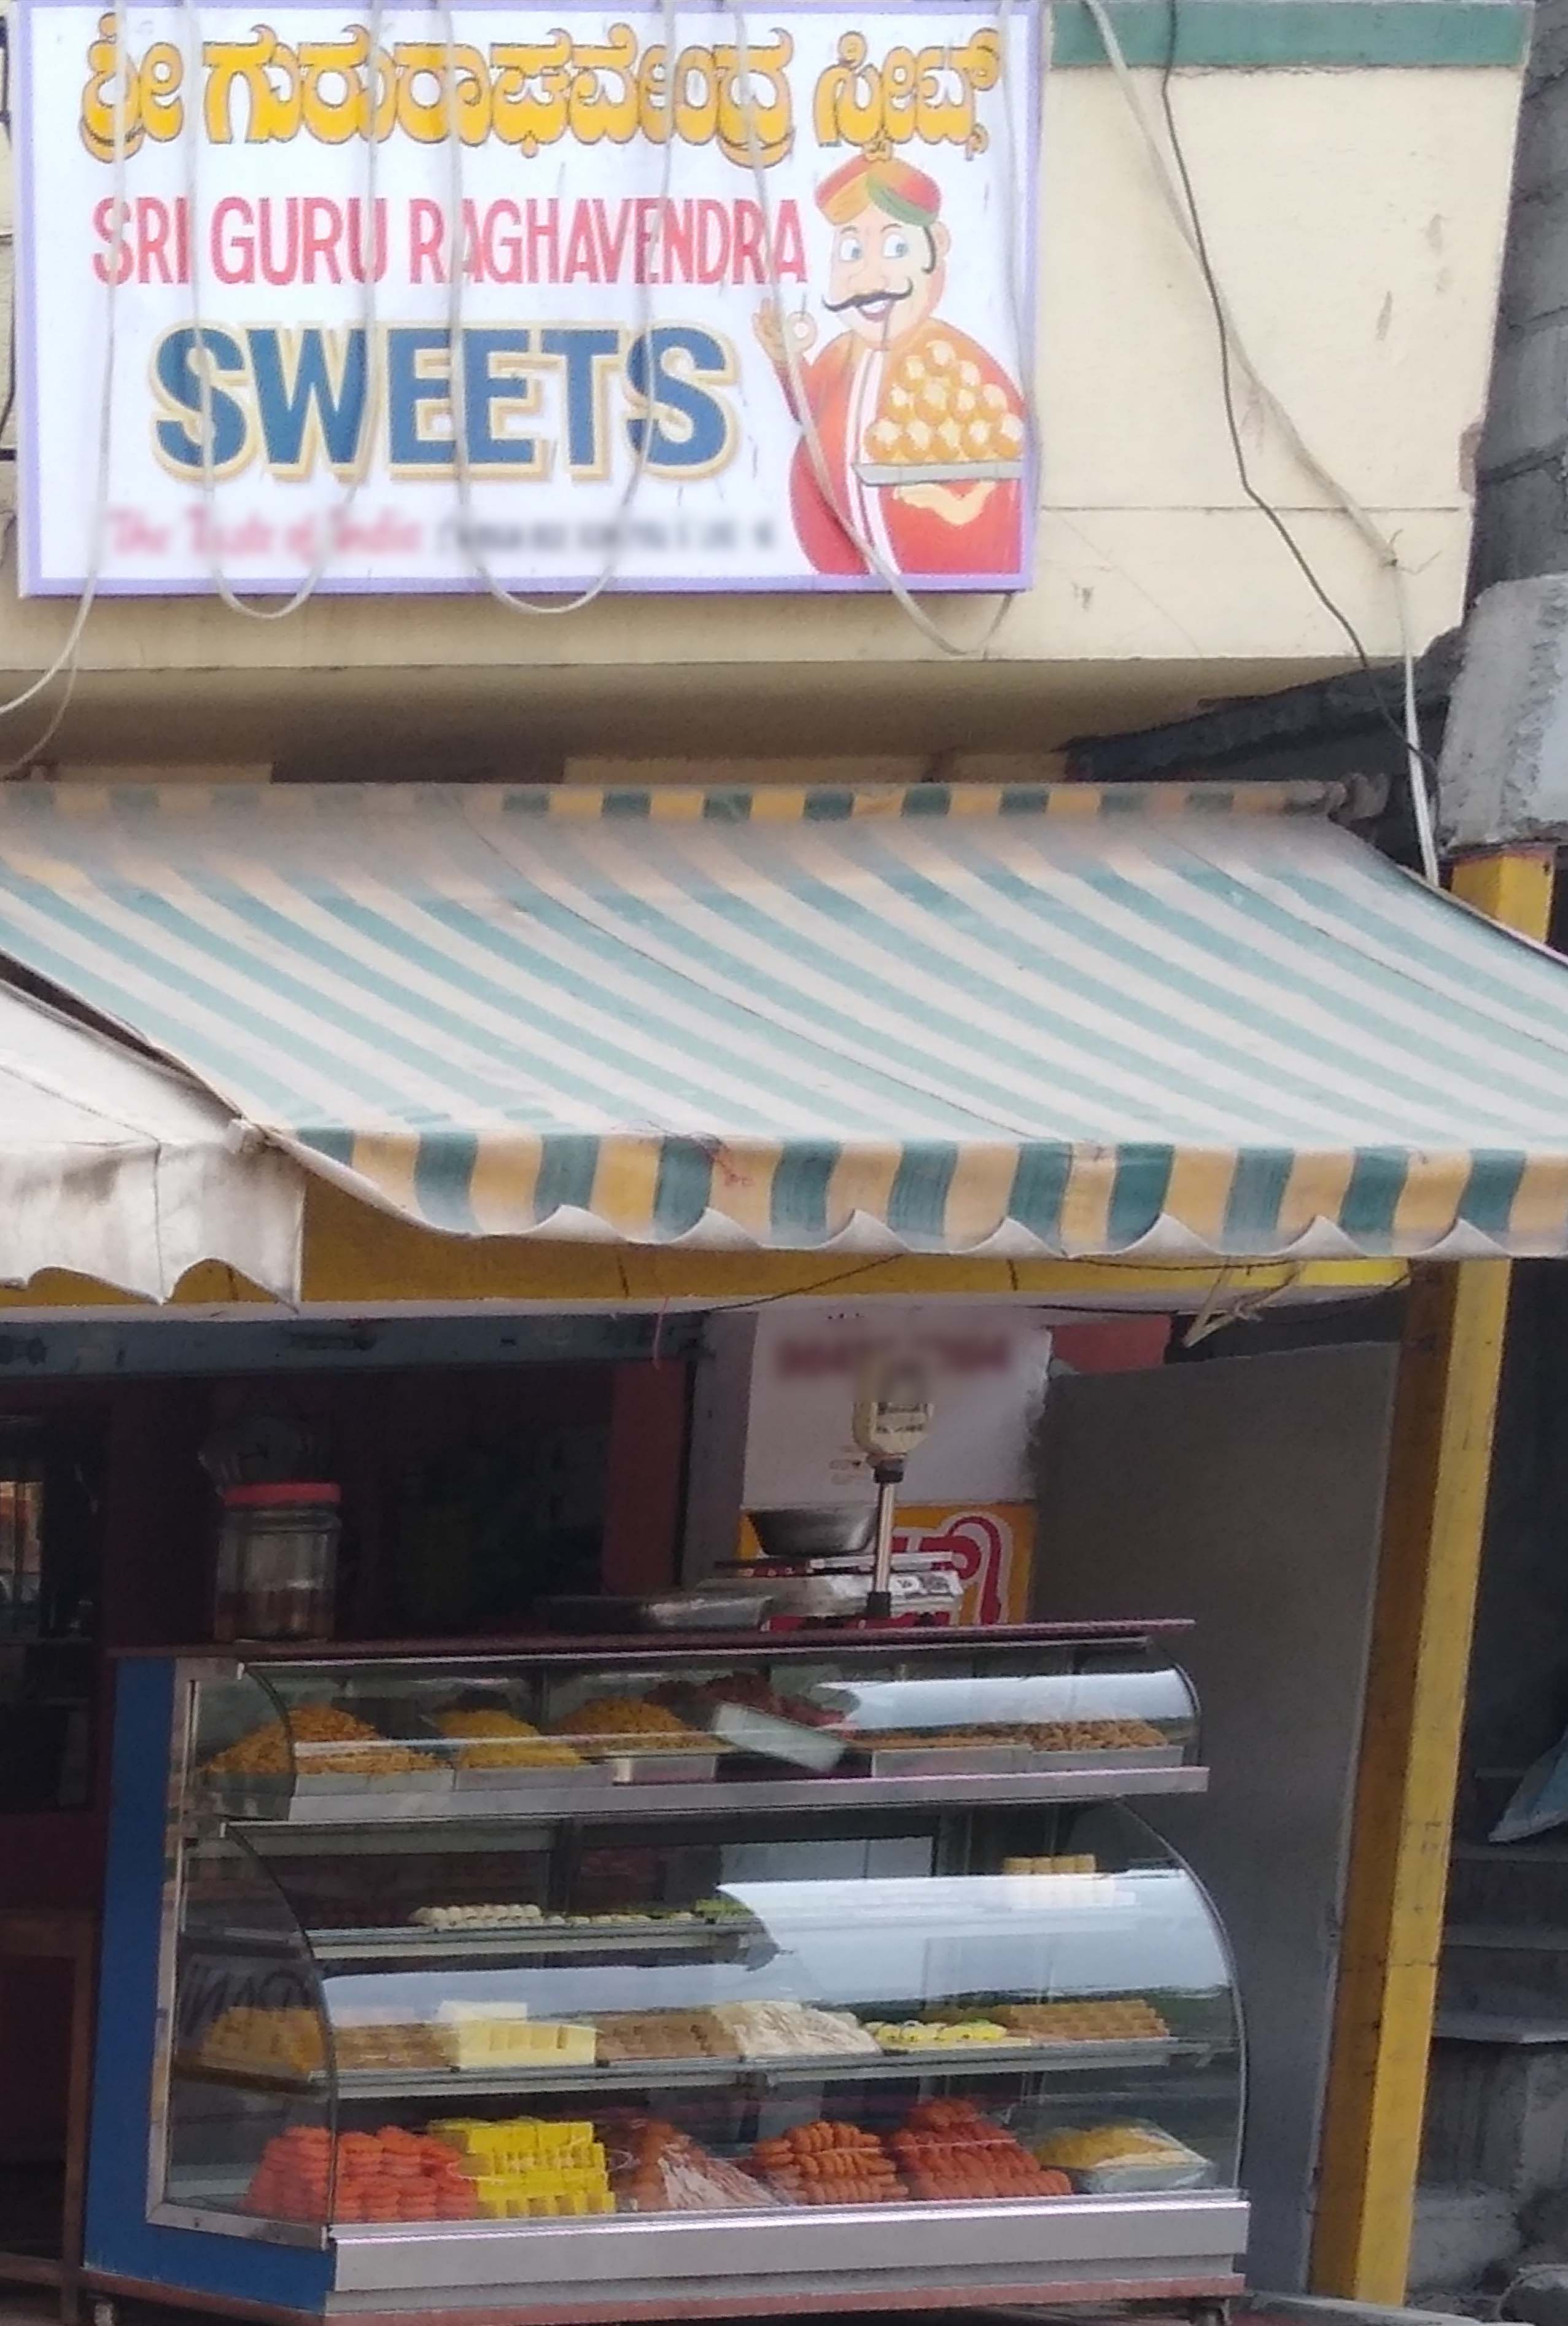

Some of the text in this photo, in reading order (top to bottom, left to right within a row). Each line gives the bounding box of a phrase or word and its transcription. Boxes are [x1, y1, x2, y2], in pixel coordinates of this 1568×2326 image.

[79, 12, 184, 163] ಶ್ರೀ
[93, 196, 808, 285] SRI GURU RAGHAVENDRA
[149, 320, 738, 484] SWEETS
